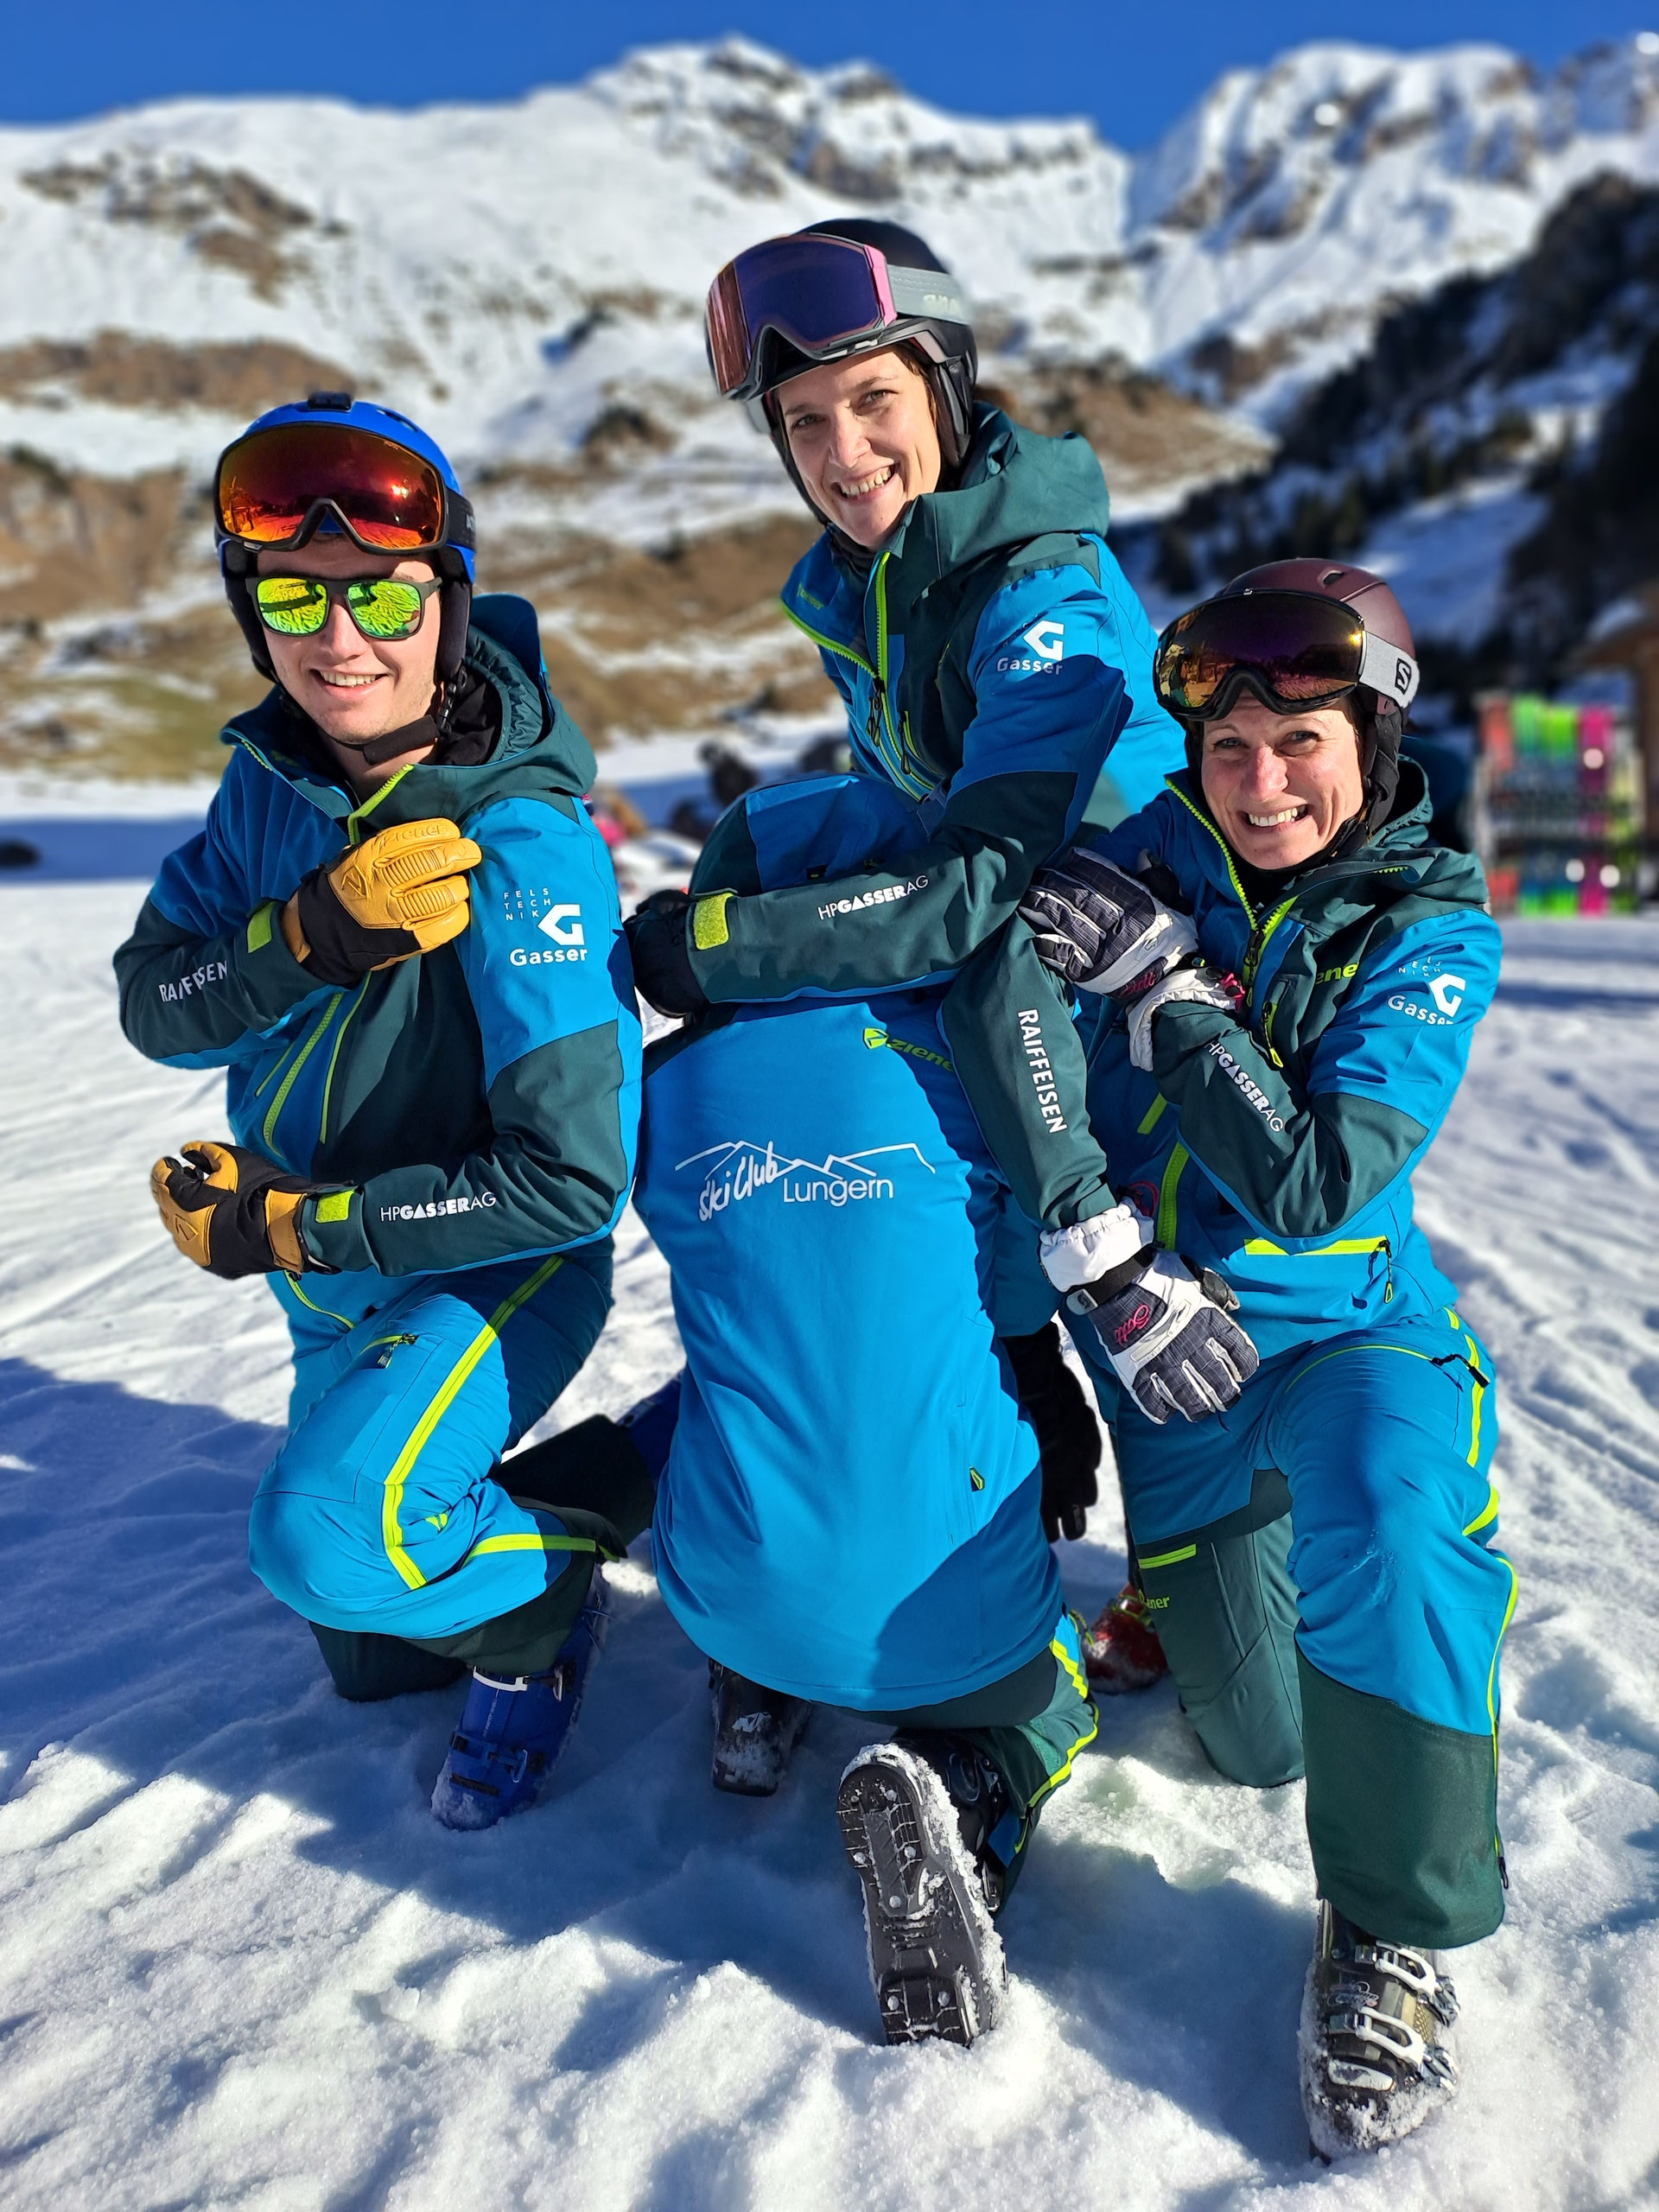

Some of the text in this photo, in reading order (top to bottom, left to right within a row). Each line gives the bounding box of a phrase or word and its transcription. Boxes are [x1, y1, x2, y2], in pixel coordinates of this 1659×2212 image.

[996, 657, 1063, 675] Gasser
[504, 887, 550, 899] FELS
[504, 898, 552, 911] TECH
[505, 910, 540, 921] NIK
[509, 948, 588, 967] Gasser
[887, 1039, 955, 1072] ziene
[1017, 1008, 1068, 1134] RAIFFEISEN
[782, 1177, 894, 1207] Lungern
